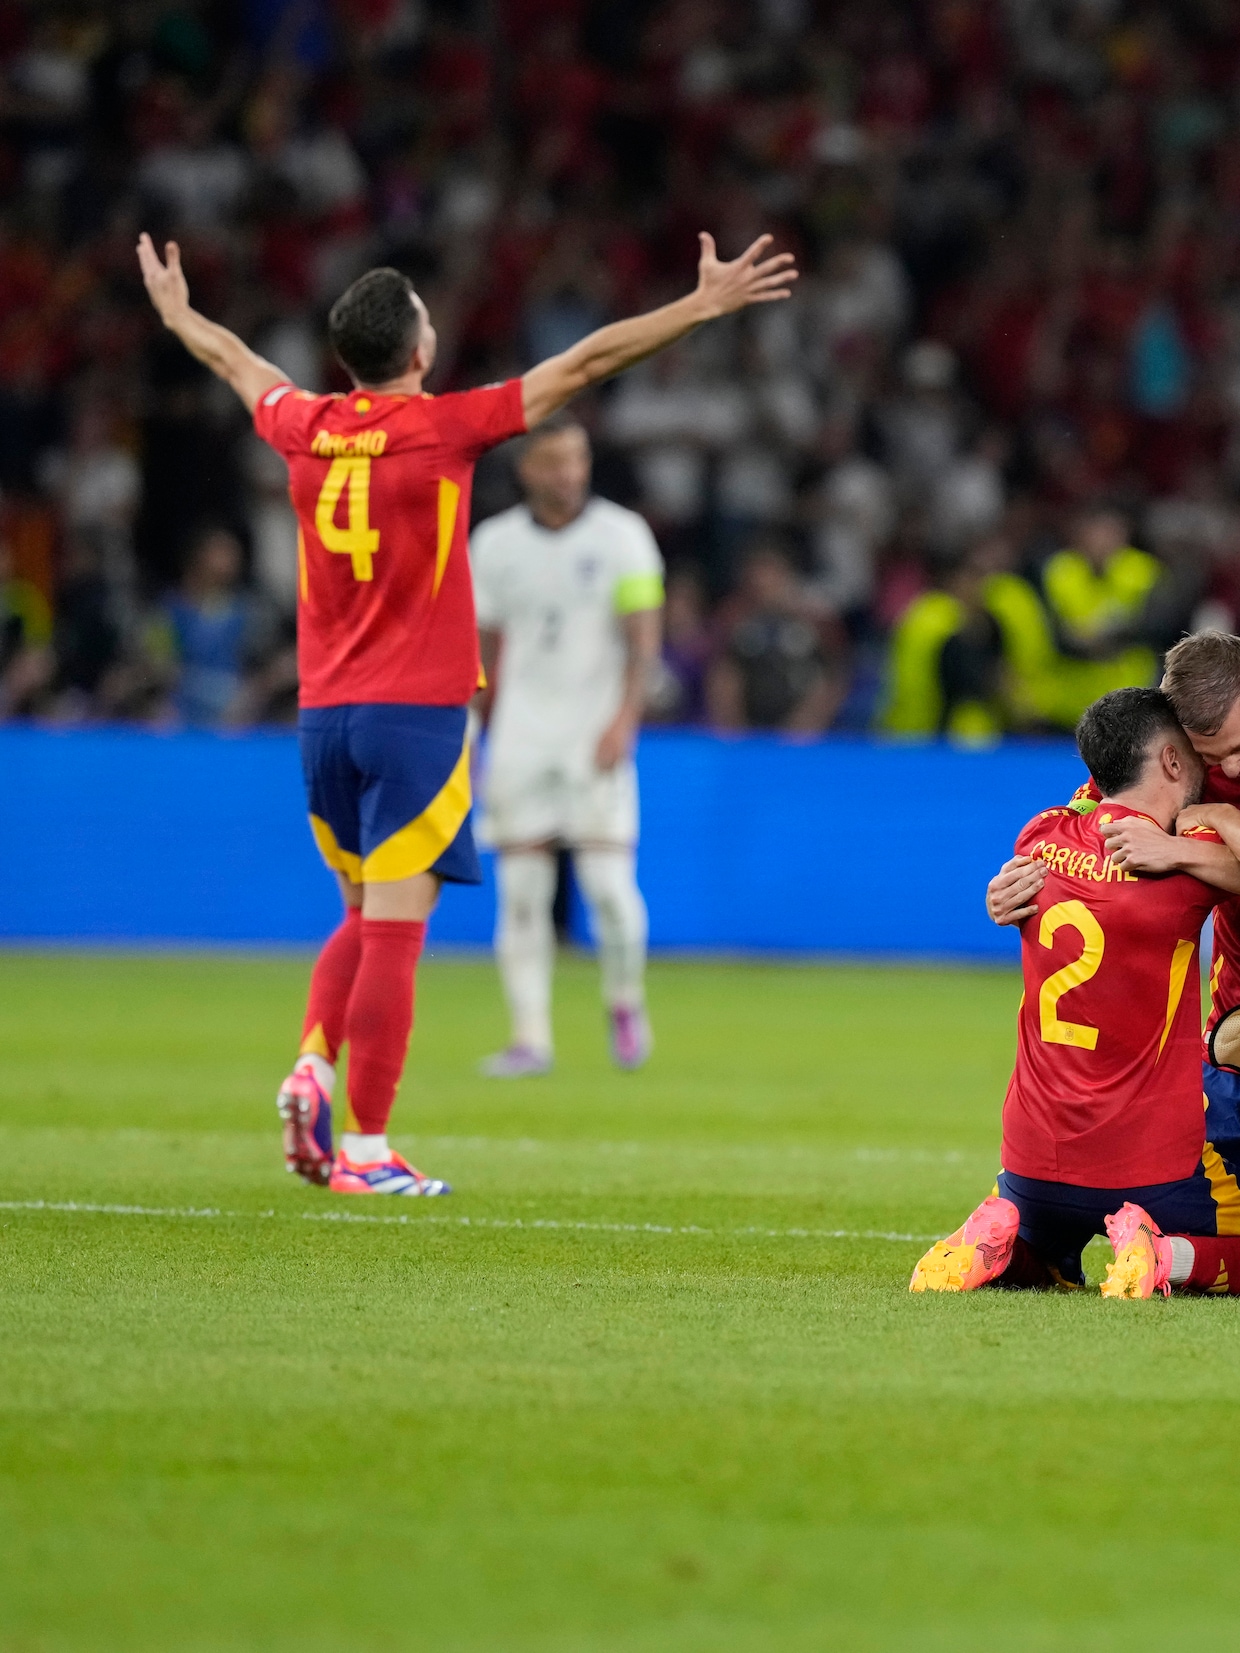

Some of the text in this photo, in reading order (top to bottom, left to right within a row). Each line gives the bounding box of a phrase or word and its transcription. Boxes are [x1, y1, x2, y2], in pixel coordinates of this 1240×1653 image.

[311, 429, 388, 458] NACHO
[315, 456, 380, 582] 4
[1038, 899, 1105, 1051] 2
